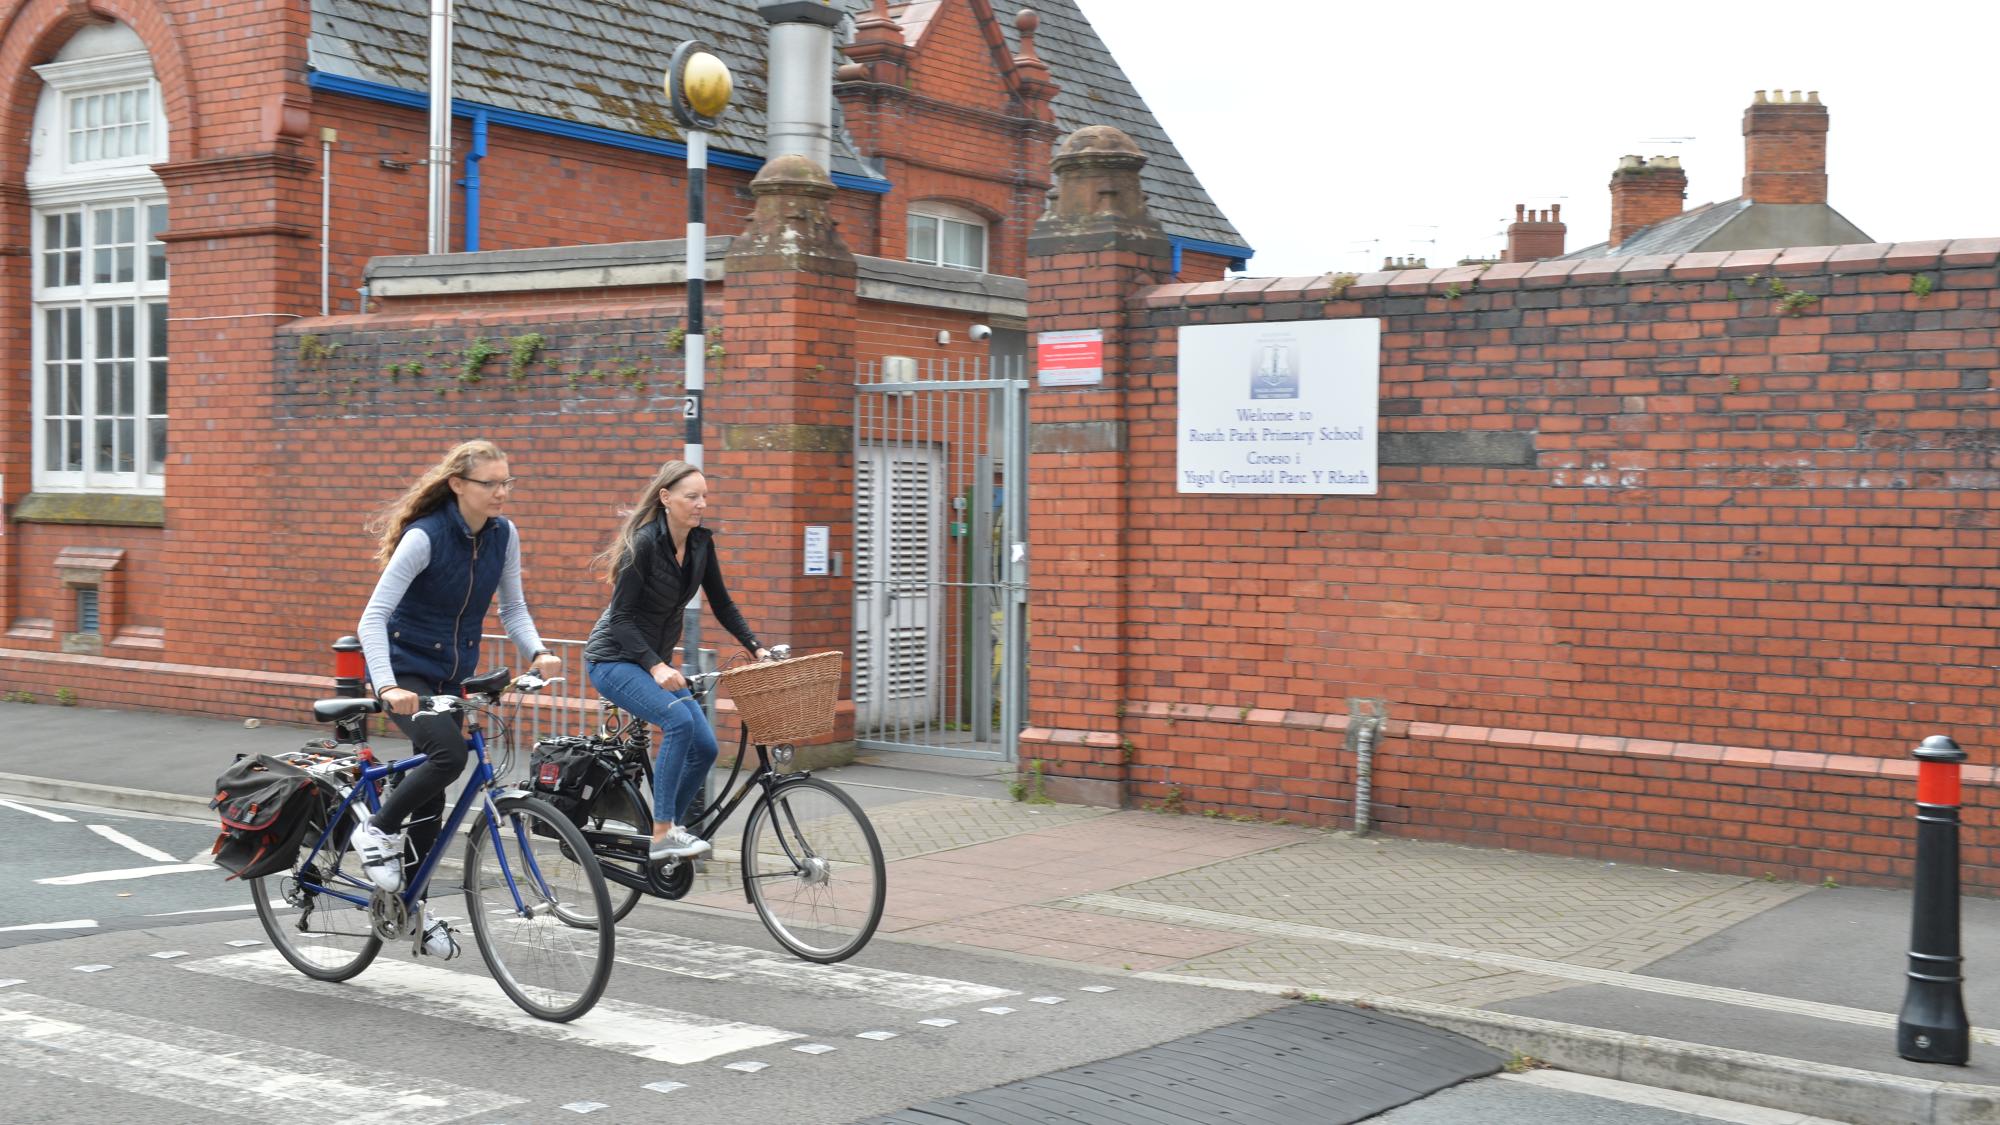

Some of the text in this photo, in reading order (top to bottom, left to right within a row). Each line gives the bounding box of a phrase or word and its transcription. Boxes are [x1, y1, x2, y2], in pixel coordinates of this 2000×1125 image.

[686, 398, 695, 416] 2
[1236, 408, 1312, 421] Welcome to
[1189, 426, 1364, 445] Roath Park Primary School
[1246, 451, 1291, 465] Croeso
[1184, 470, 1215, 488] Ysgol
[1279, 470, 1306, 484] Parc
[1312, 470, 1323, 484] Y
[1328, 470, 1369, 484] Rhath
